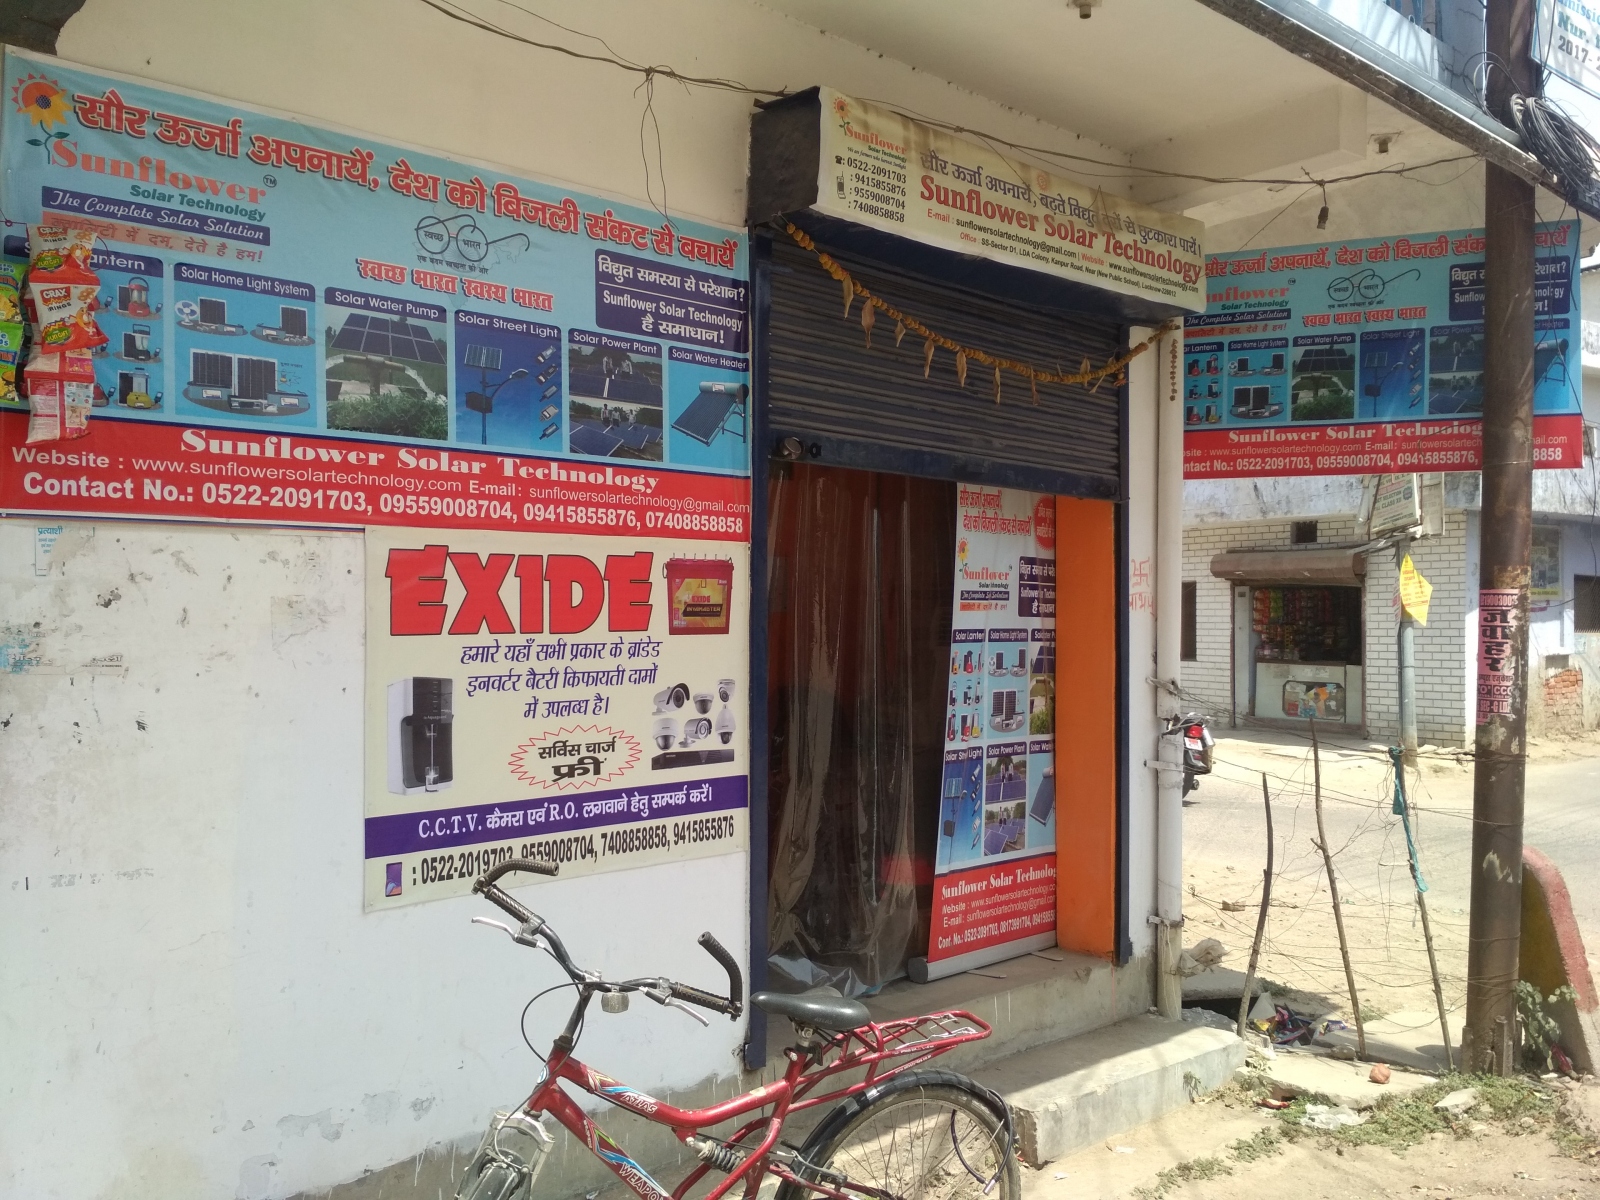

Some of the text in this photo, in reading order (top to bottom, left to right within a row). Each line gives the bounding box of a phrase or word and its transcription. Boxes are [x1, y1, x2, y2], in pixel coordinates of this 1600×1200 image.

[846, 124, 907, 155] Sunflower
[51, 138, 267, 204] Sunflower
[73, 88, 739, 269] सौर ऊर्जा अपनायें, देश को बिजली संकट से बचायें
[847, 157, 906, 184] 0522-2091703
[854, 173, 906, 197] 9415855876
[130, 184, 266, 222] Solar Technology
[853, 200, 905, 223] 7408858858
[854, 186, 906, 210] 9559008704
[49, 190, 264, 240] The Complete Solar Solution
[920, 174, 1202, 285] Sunflower Solar Technology
[927, 208, 950, 223] E-mail
[1336, 245, 1363, 264] देश
[1367, 241, 1391, 263] को
[1394, 234, 1450, 260] बिजली
[43, 287, 67, 299] CRAX
[181, 266, 310, 297] Solar Home Light System
[412, 267, 458, 294] भारत
[512, 287, 554, 311] भारत
[637, 267, 681, 289] समस्या
[684, 275, 696, 291] से
[335, 291, 439, 319] Solar Water Pump
[603, 290, 742, 332] Sunflower Solar Technology
[1221, 299, 1289, 311] Solar Technology
[458, 311, 559, 340] Solar Street Light
[641, 313, 654, 333] है
[573, 331, 658, 355] Solar Power Plant
[1297, 335, 1352, 345] Solar Water Pump
[672, 349, 747, 370] Solar Water Heater
[1228, 425, 1376, 443] Sunflower Solar
[180, 428, 660, 494] Sunflower Solar Technology
[12, 446, 110, 469] Website
[133, 458, 462, 493] www.sunflowersolartechnology.com
[529, 486, 750, 513] sunflowersolartechnology@gmail.com
[23, 471, 744, 534] Contact No.: 0522-2091703, 09559008704, 09415855876, 07408858858
[385, 544, 654, 636] EXIDE
[460, 639, 500, 665] हमारे
[536, 639, 567, 661] सभी
[569, 642, 605, 661] प्रकार
[609, 636, 625, 660] के
[466, 667, 522, 697] इनवर्टर
[525, 667, 560, 690] बैटरी
[562, 664, 627, 689] किफायती
[523, 697, 539, 719] में
[538, 736, 617, 759] सर्विस चार्ज
[418, 813, 482, 839] C.C.T.V.
[486, 808, 524, 830] कैमरा
[527, 802, 548, 824] एवं
[550, 800, 579, 821] R.O.
[582, 794, 628, 818] लगवाने
[630, 792, 649, 816] हेतु
[600, 822, 670, 856] 7408858858,
[673, 815, 735, 845] 9415855876
[942, 872, 1014, 900] Sunflower Solar
[620, 1093, 658, 1114] ATLAS
[619, 1161, 665, 1200] WEAPO
